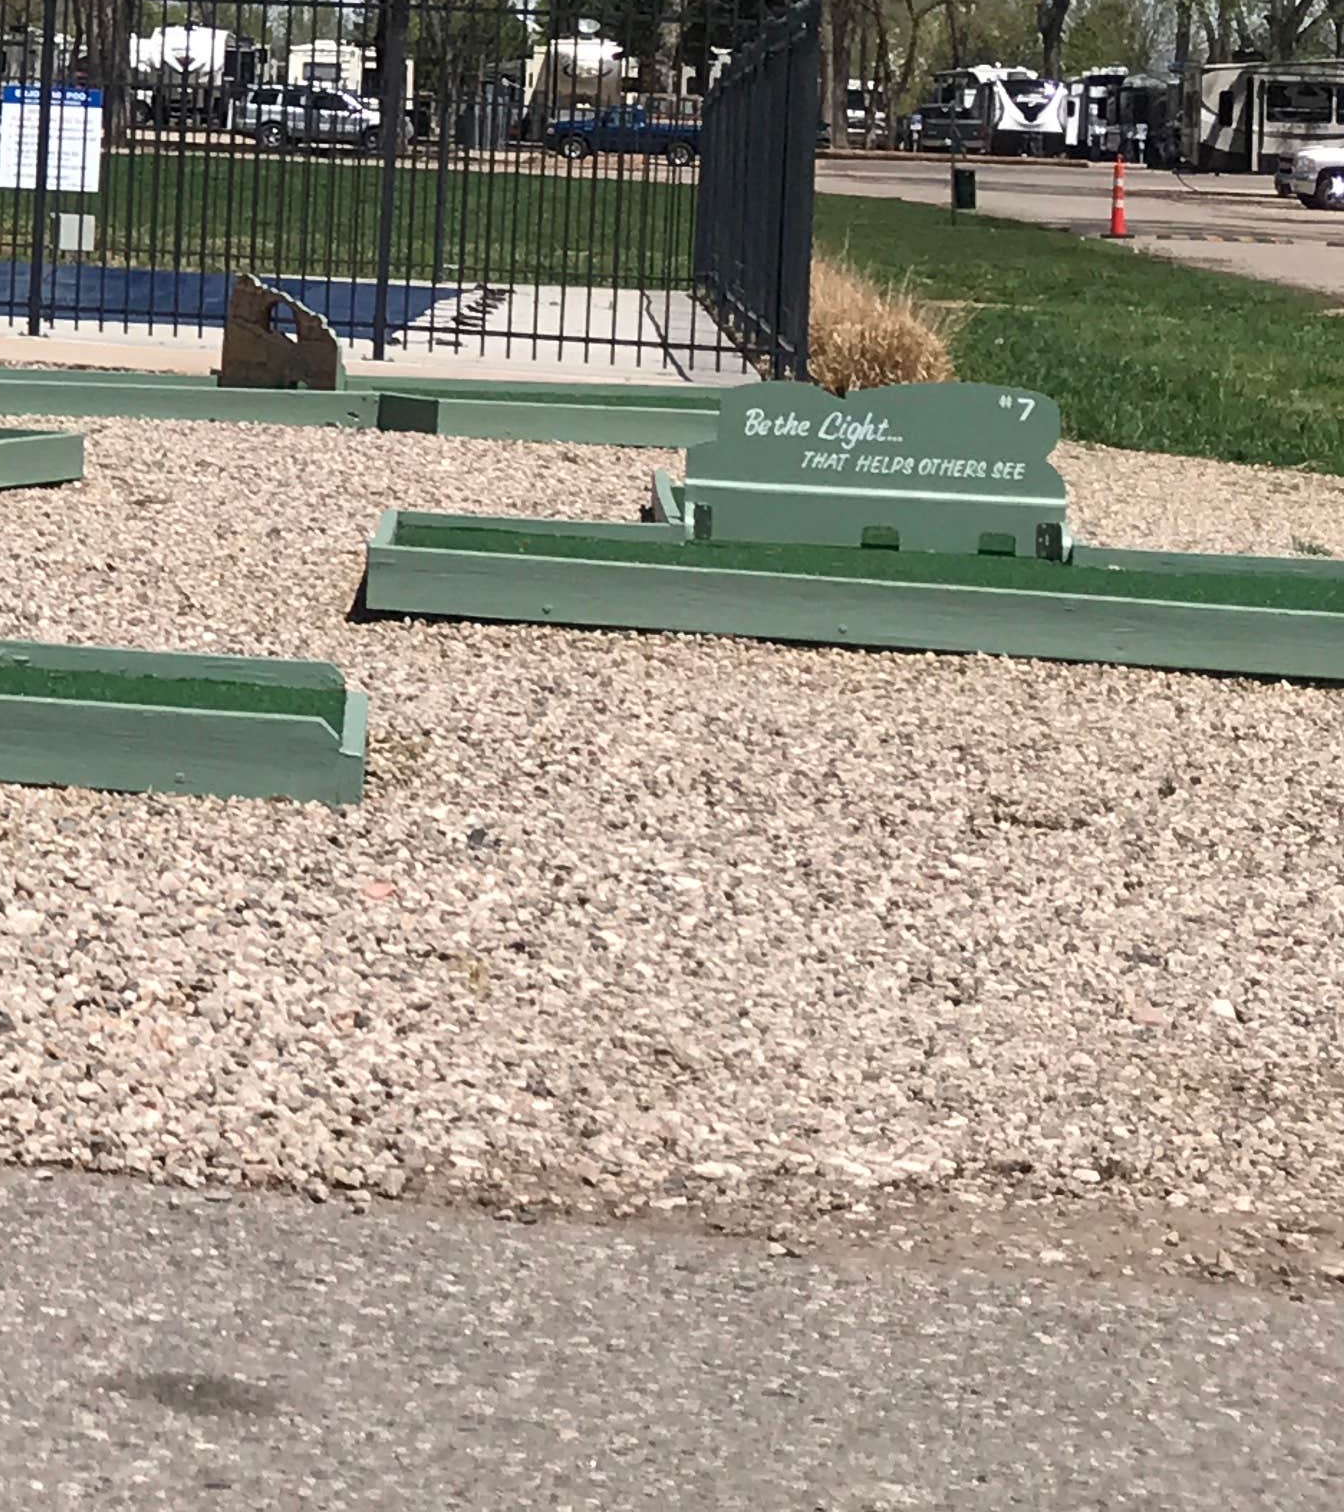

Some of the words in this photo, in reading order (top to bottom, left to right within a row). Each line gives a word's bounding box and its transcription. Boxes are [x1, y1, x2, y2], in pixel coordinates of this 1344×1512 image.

[744, 408, 771, 436] Be
[773, 412, 810, 437] the
[801, 451, 850, 471] THAT
[855, 455, 913, 475] HELPS
[918, 458, 988, 478] OTHERS
[991, 462, 1026, 480] SEE
